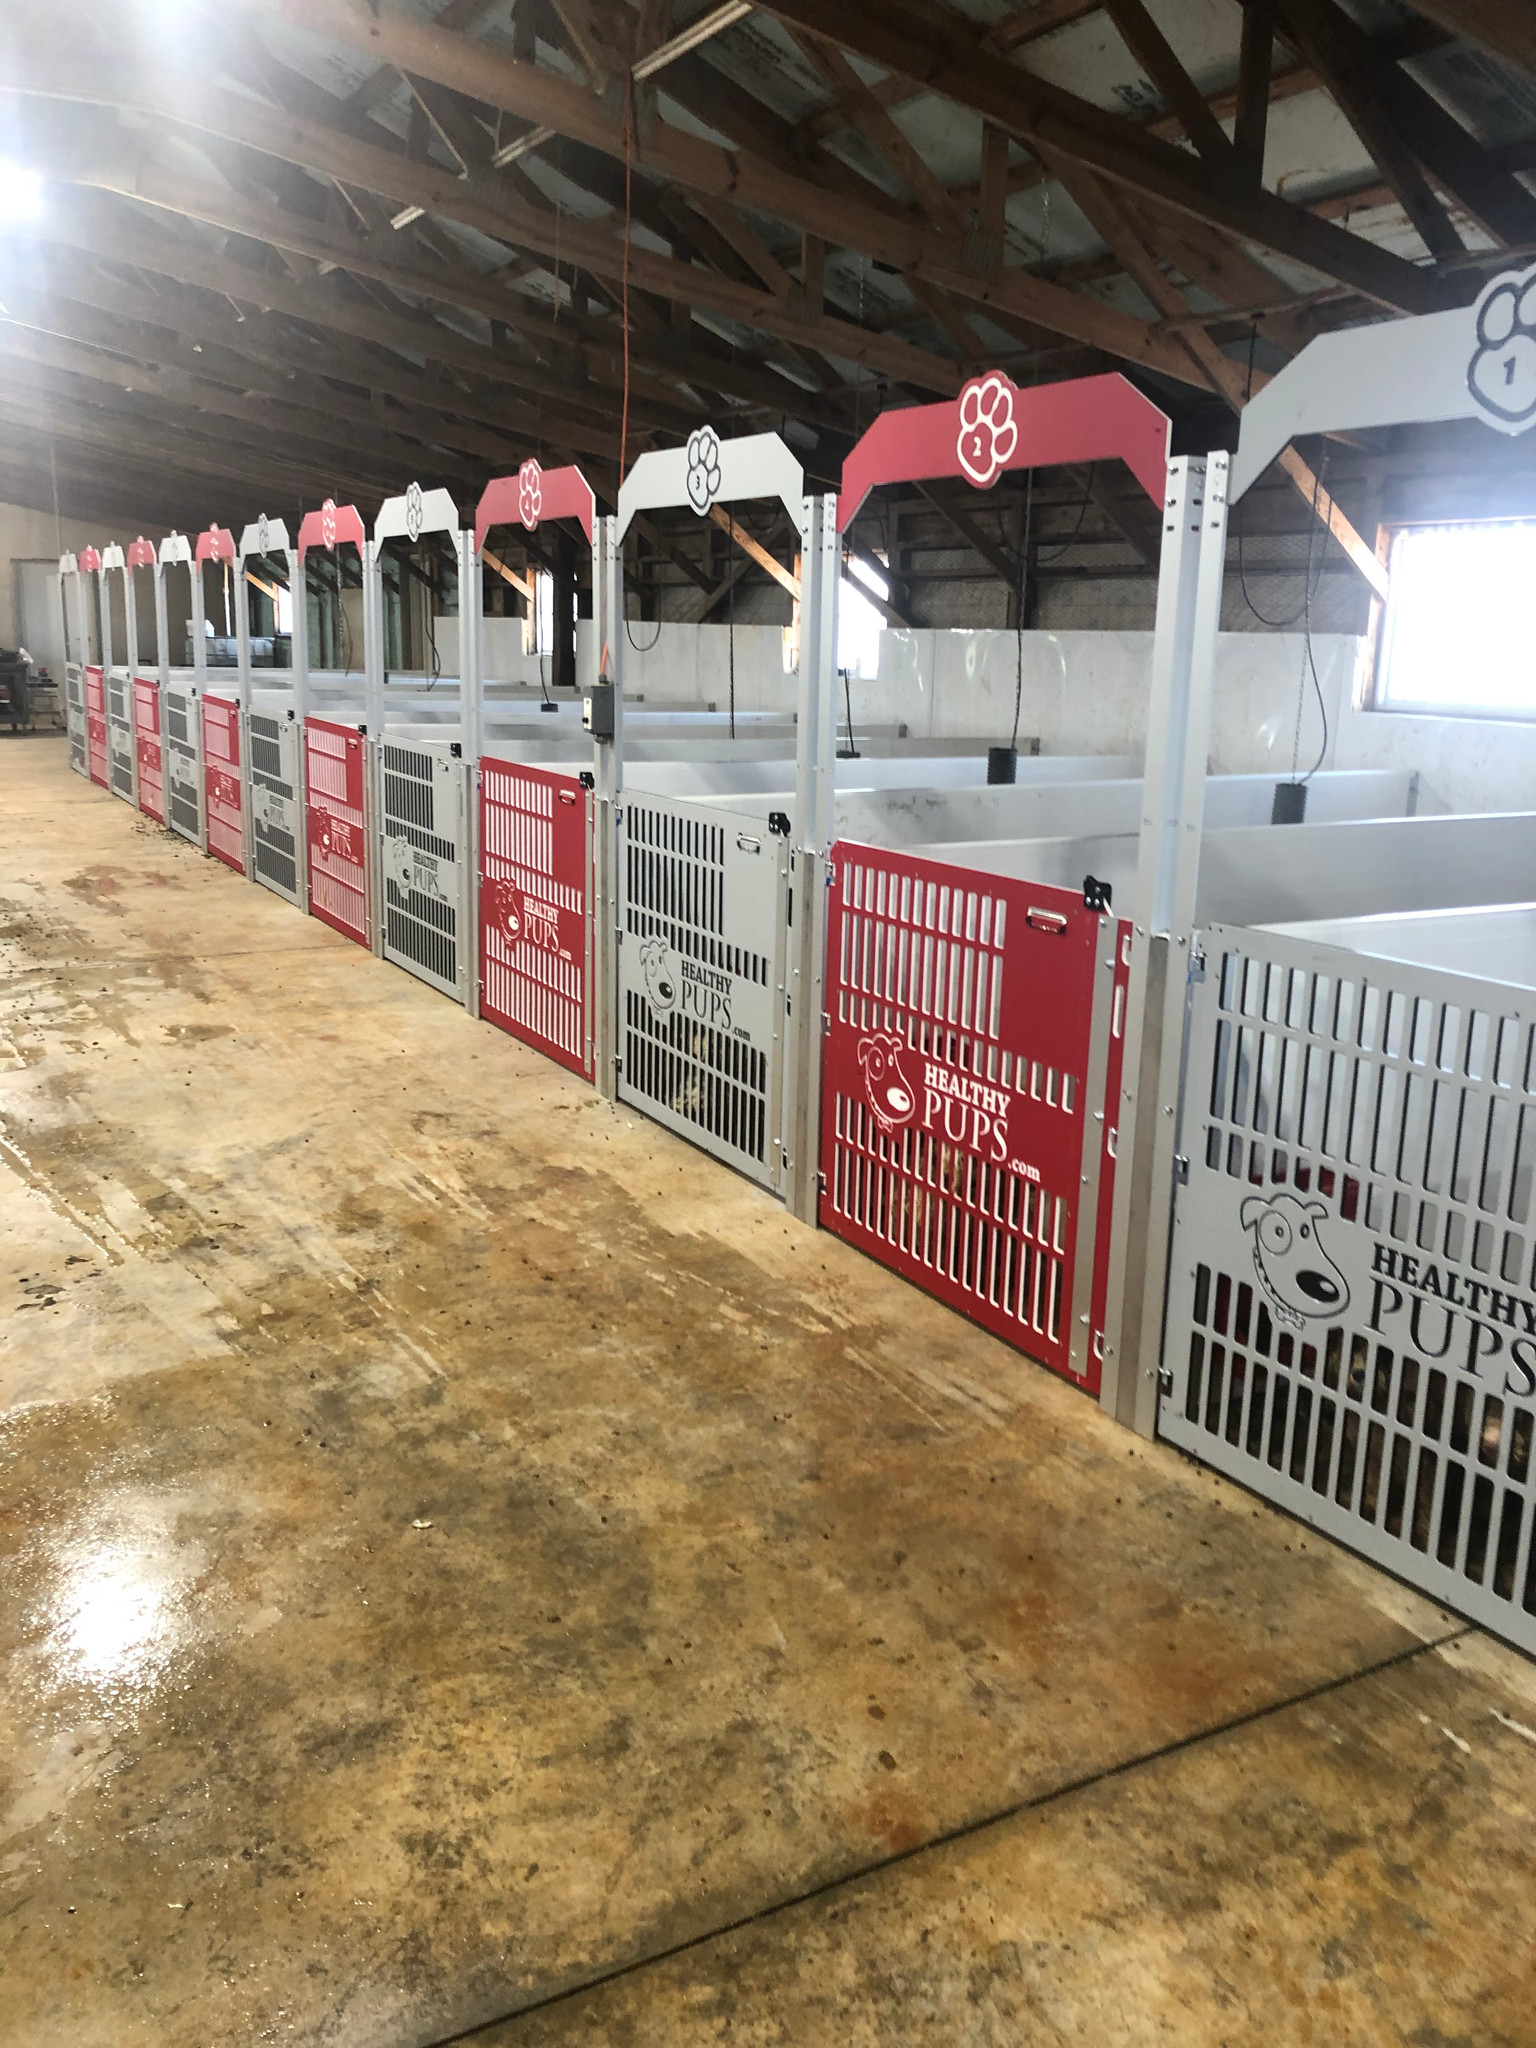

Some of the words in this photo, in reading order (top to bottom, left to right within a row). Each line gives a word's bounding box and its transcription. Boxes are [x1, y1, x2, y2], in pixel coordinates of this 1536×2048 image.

[1503, 356, 1516, 386] 1
[972, 435, 982, 457] 2
[681, 960, 733, 995] HEALTHY
[923, 1062, 1011, 1118] HEALTHY
[1363, 1275, 1536, 1397] PUPS
